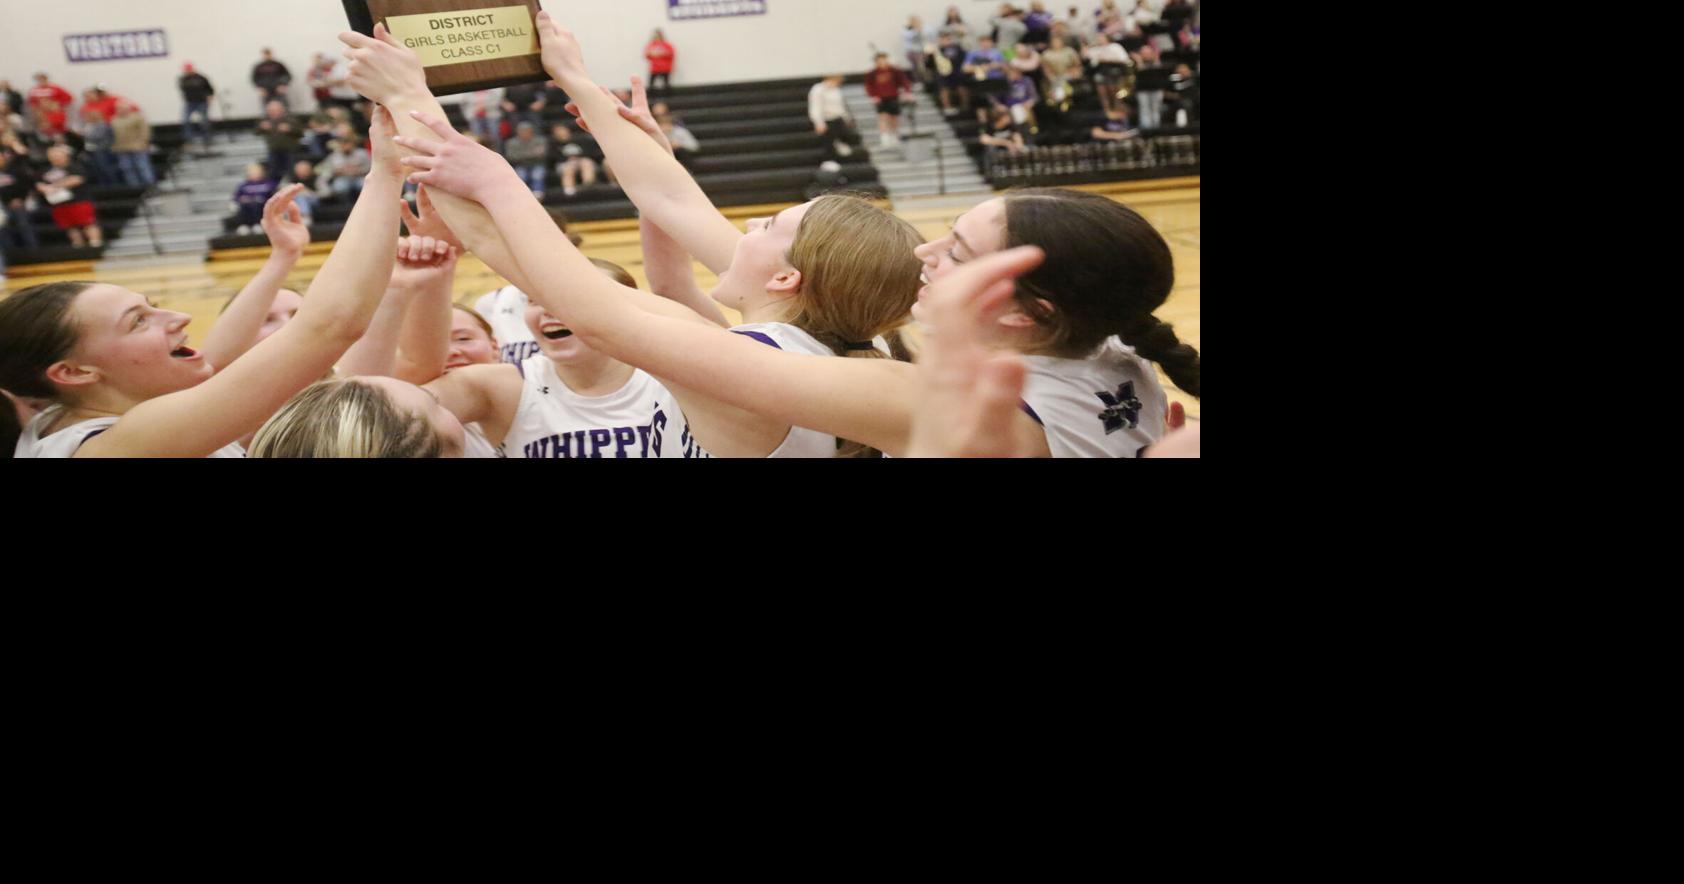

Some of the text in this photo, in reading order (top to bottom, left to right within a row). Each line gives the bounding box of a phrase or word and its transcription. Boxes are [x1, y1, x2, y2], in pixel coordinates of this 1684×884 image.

[429, 14, 494, 30] DISTRICT
[65, 32, 164, 59] VISITORS
[404, 27, 527, 48] GIRLS BASKETBALL
[440, 43, 502, 59] CLASS C1
